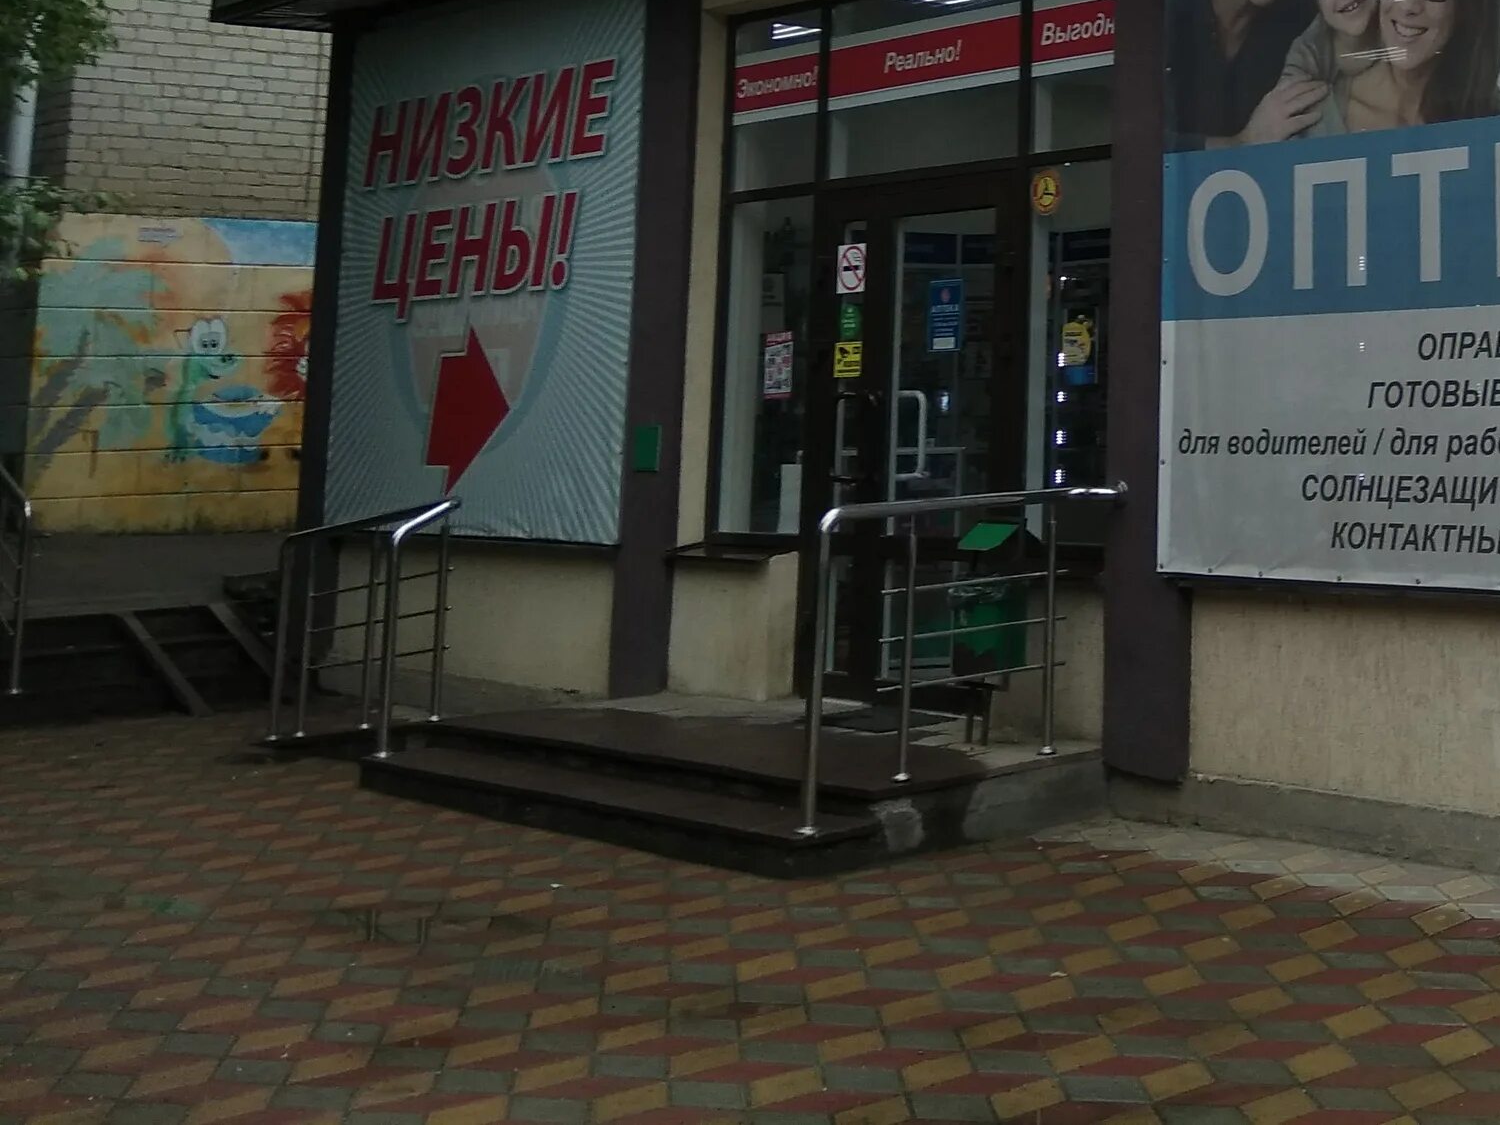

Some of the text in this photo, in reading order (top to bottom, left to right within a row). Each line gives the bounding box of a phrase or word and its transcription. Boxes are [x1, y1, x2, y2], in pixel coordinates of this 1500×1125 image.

[884, 39, 962, 74] Реально!
[737, 65, 819, 98] Экономно!
[363, 58, 617, 190] НИЗКИЕ
[370, 191, 580, 324] ЦЕНЫ!
[1178, 431, 1220, 457] для
[1226, 427, 1367, 457] водителей
[1389, 429, 1441, 460] для
